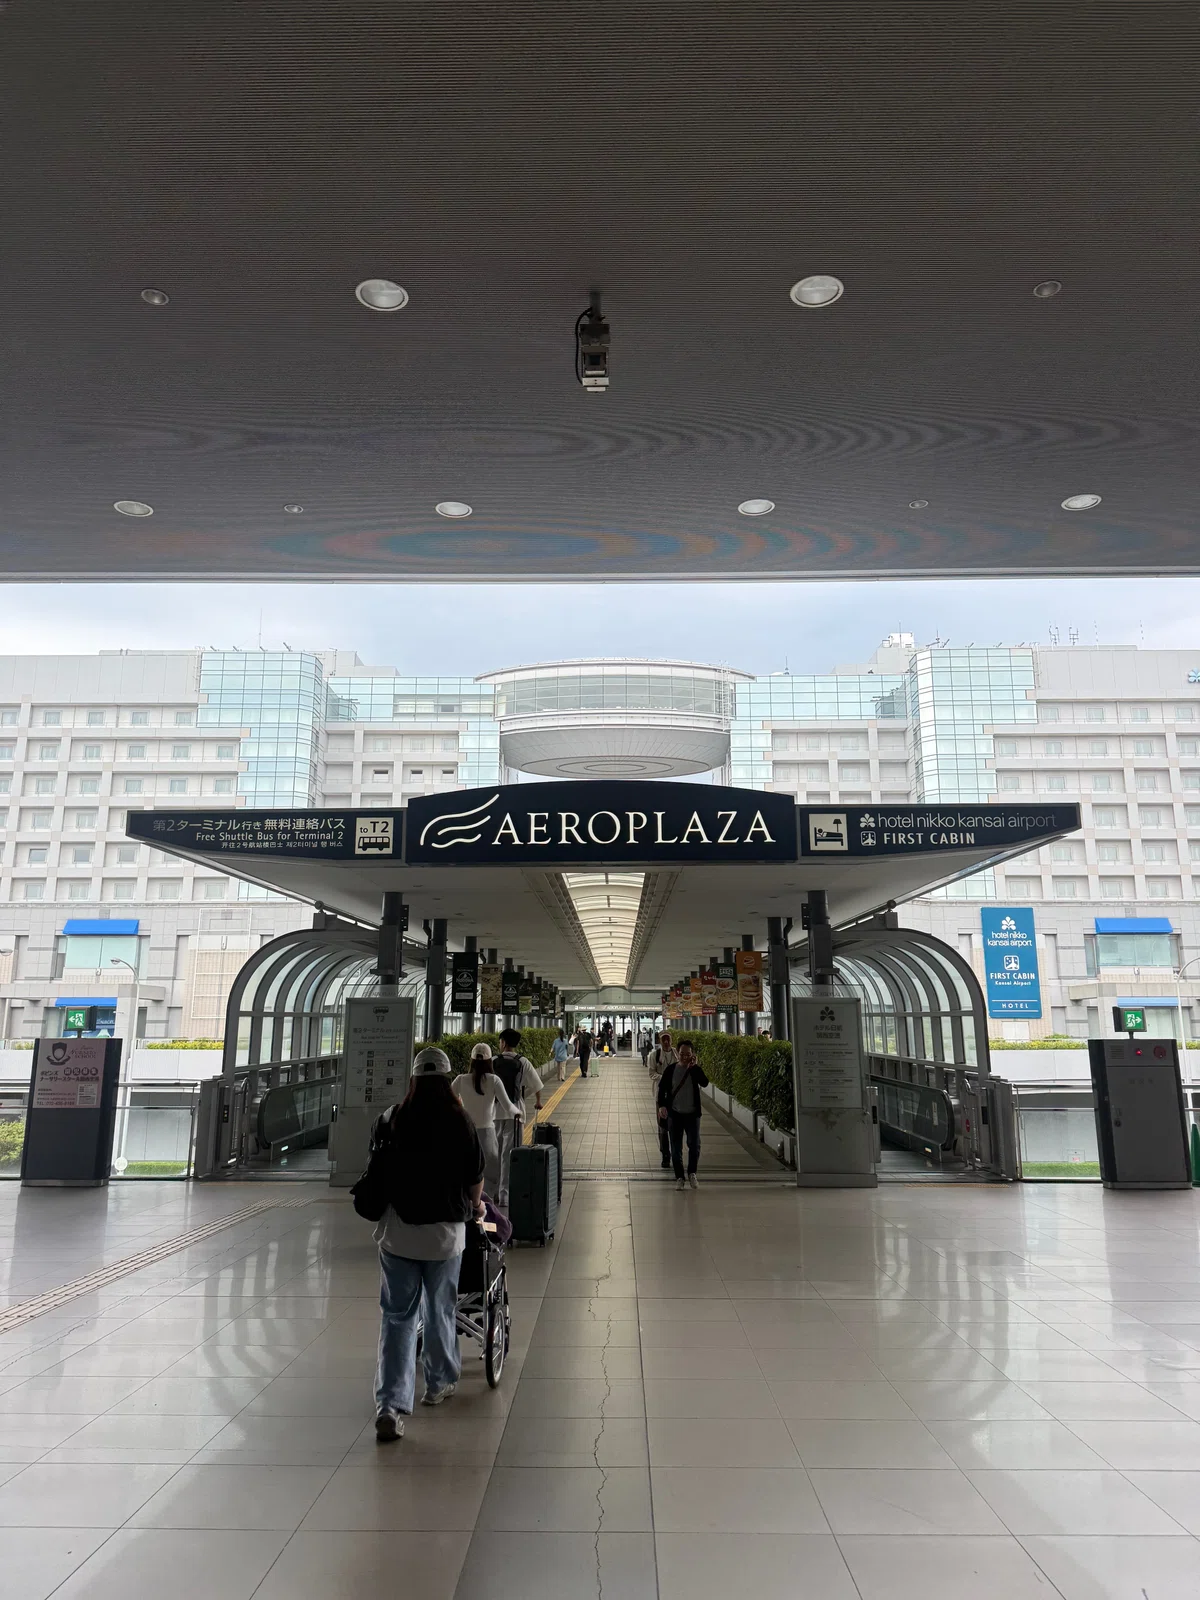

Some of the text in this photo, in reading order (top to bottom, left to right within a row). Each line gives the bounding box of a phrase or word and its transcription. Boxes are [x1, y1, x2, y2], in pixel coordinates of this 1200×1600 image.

[370, 821, 389, 833] T2
[491, 809, 776, 845] AEROPLAZA
[878, 812, 1057, 831] hotel nikko kansai airport
[196, 831, 344, 841] Free Shuttle Bus for Terminal 2
[883, 832, 975, 845] FIRST CABIN
[991, 931, 1027, 939] hotel nikko
[987, 939, 1032, 948] kansai airport
[990, 972, 1035, 980] FIRST CABIN
